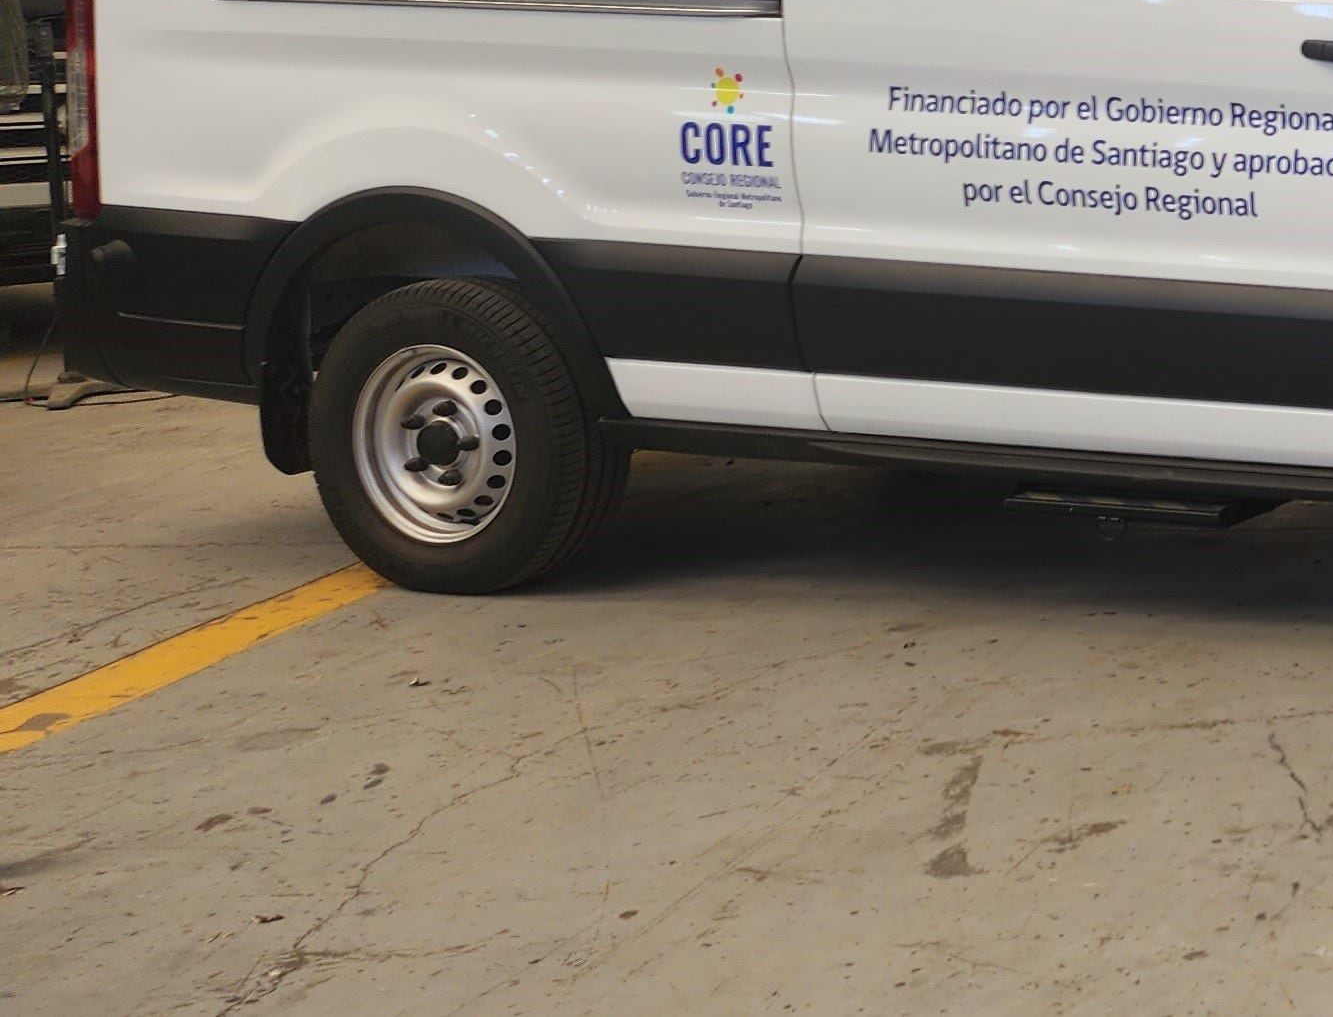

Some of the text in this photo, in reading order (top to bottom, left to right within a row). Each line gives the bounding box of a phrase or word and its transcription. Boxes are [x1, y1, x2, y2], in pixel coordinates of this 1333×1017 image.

[888, 85, 1022, 116] Financiado
[1027, 99, 1071, 124] por
[1077, 95, 1099, 121] el
[1105, 96, 1224, 127] Gobierno
[681, 121, 774, 167] CORE
[868, 128, 1047, 164] Metropolitano
[1055, 138, 1085, 164] de
[1091, 139, 1205, 177] Santiago
[1210, 152, 1228, 178] y
[962, 180, 1258, 221] por el Consejo Regional
